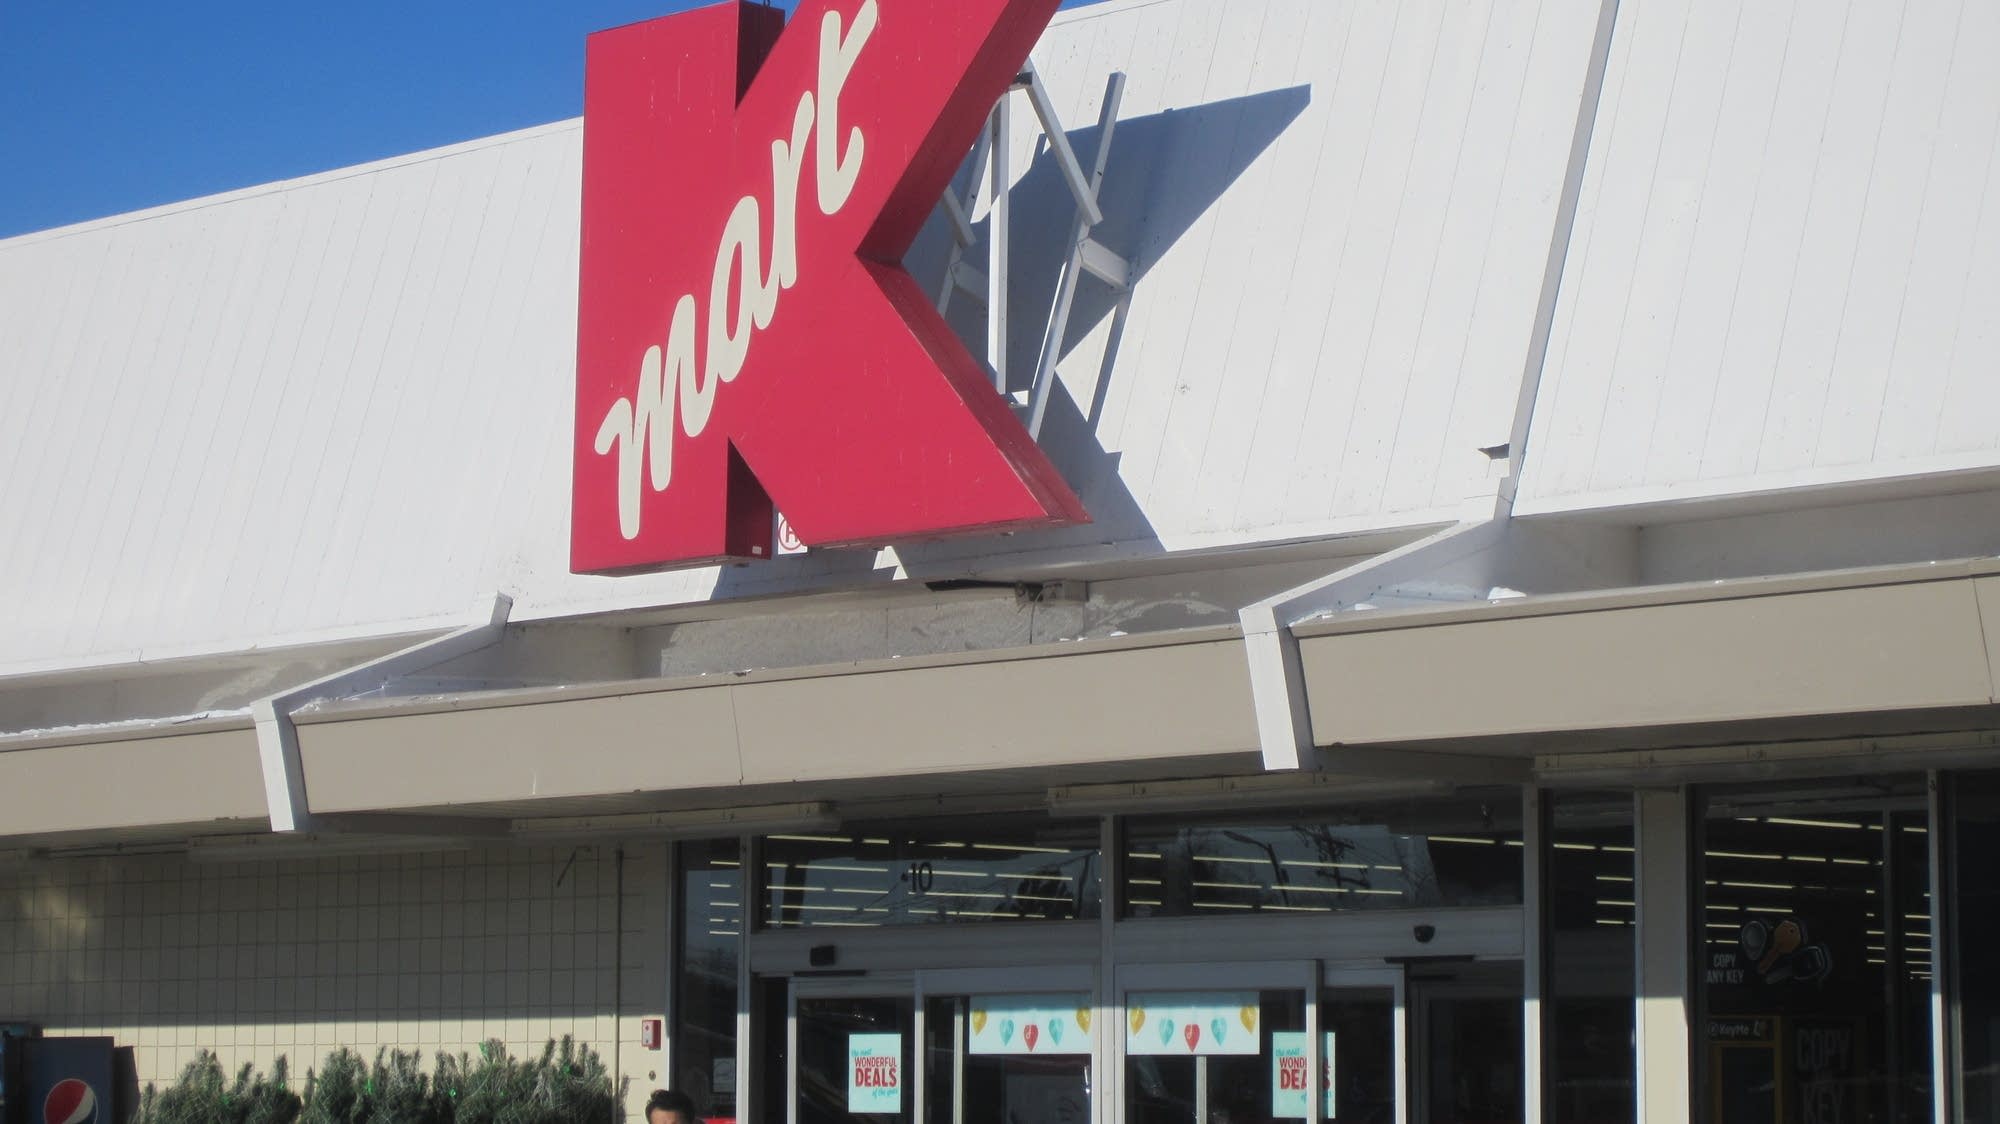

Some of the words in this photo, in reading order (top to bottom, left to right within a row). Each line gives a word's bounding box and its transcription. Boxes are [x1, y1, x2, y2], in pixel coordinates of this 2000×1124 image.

[1713, 953, 1736, 968] COPY
[1726, 969, 1744, 984] KEY
[1797, 1028, 1849, 1071] COPY
[855, 1056, 897, 1067] WONDERFUL
[855, 1068, 897, 1087] DEALS
[1803, 1083, 1844, 1124] KEY
